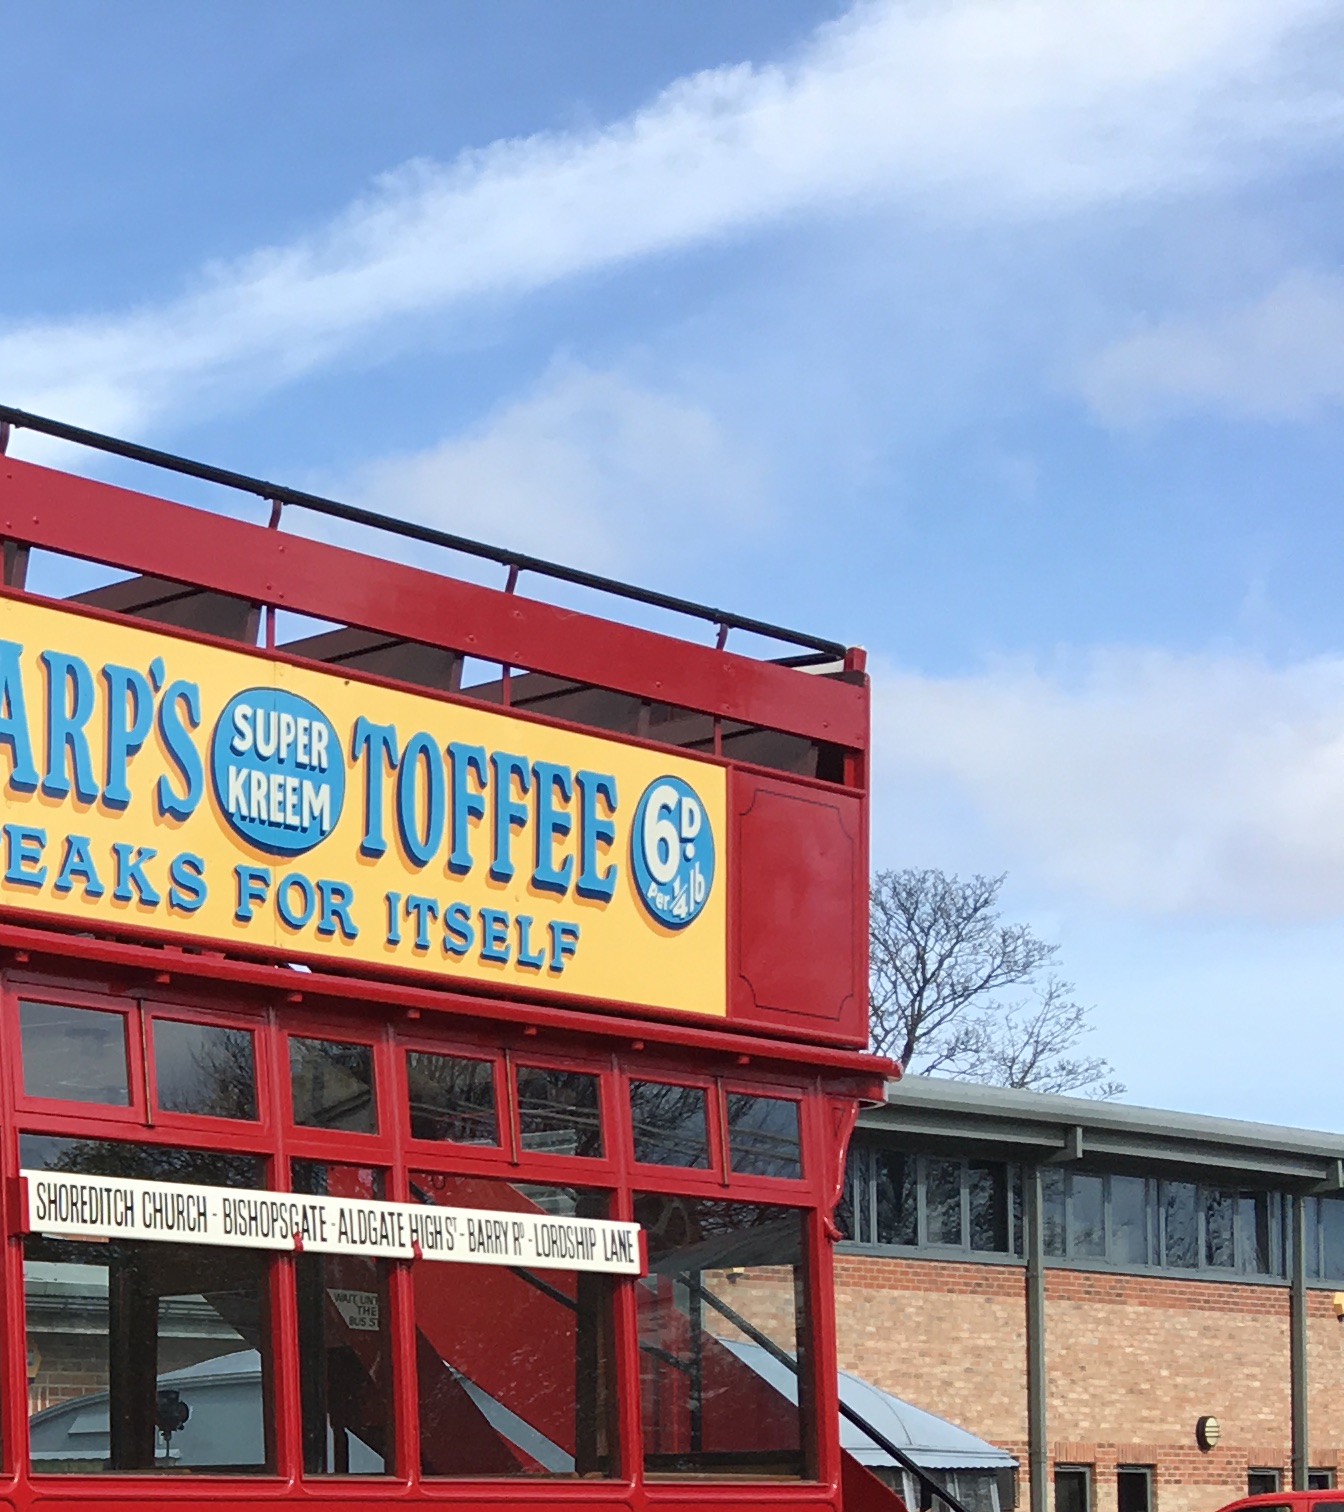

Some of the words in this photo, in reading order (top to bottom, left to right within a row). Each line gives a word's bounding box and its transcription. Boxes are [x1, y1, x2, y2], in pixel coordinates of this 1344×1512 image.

[232, 703, 330, 773] SUPER
[226, 765, 332, 836] KREEM
[352, 714, 619, 902] TOFFEE
[234, 865, 359, 939] FOR
[385, 890, 581, 973] ITSELF
[36, 1181, 135, 1228] SHOREDITCH
[142, 1190, 208, 1233] CHURCH
[222, 1197, 328, 1243] BISHOPSGATE
[338, 1207, 407, 1248] ALDGATE
[409, 1213, 443, 1249] HIGH
[466, 1218, 510, 1256] BARRY
[533, 1223, 597, 1262] LORDSHIP
[602, 1227, 635, 1264] LANE
